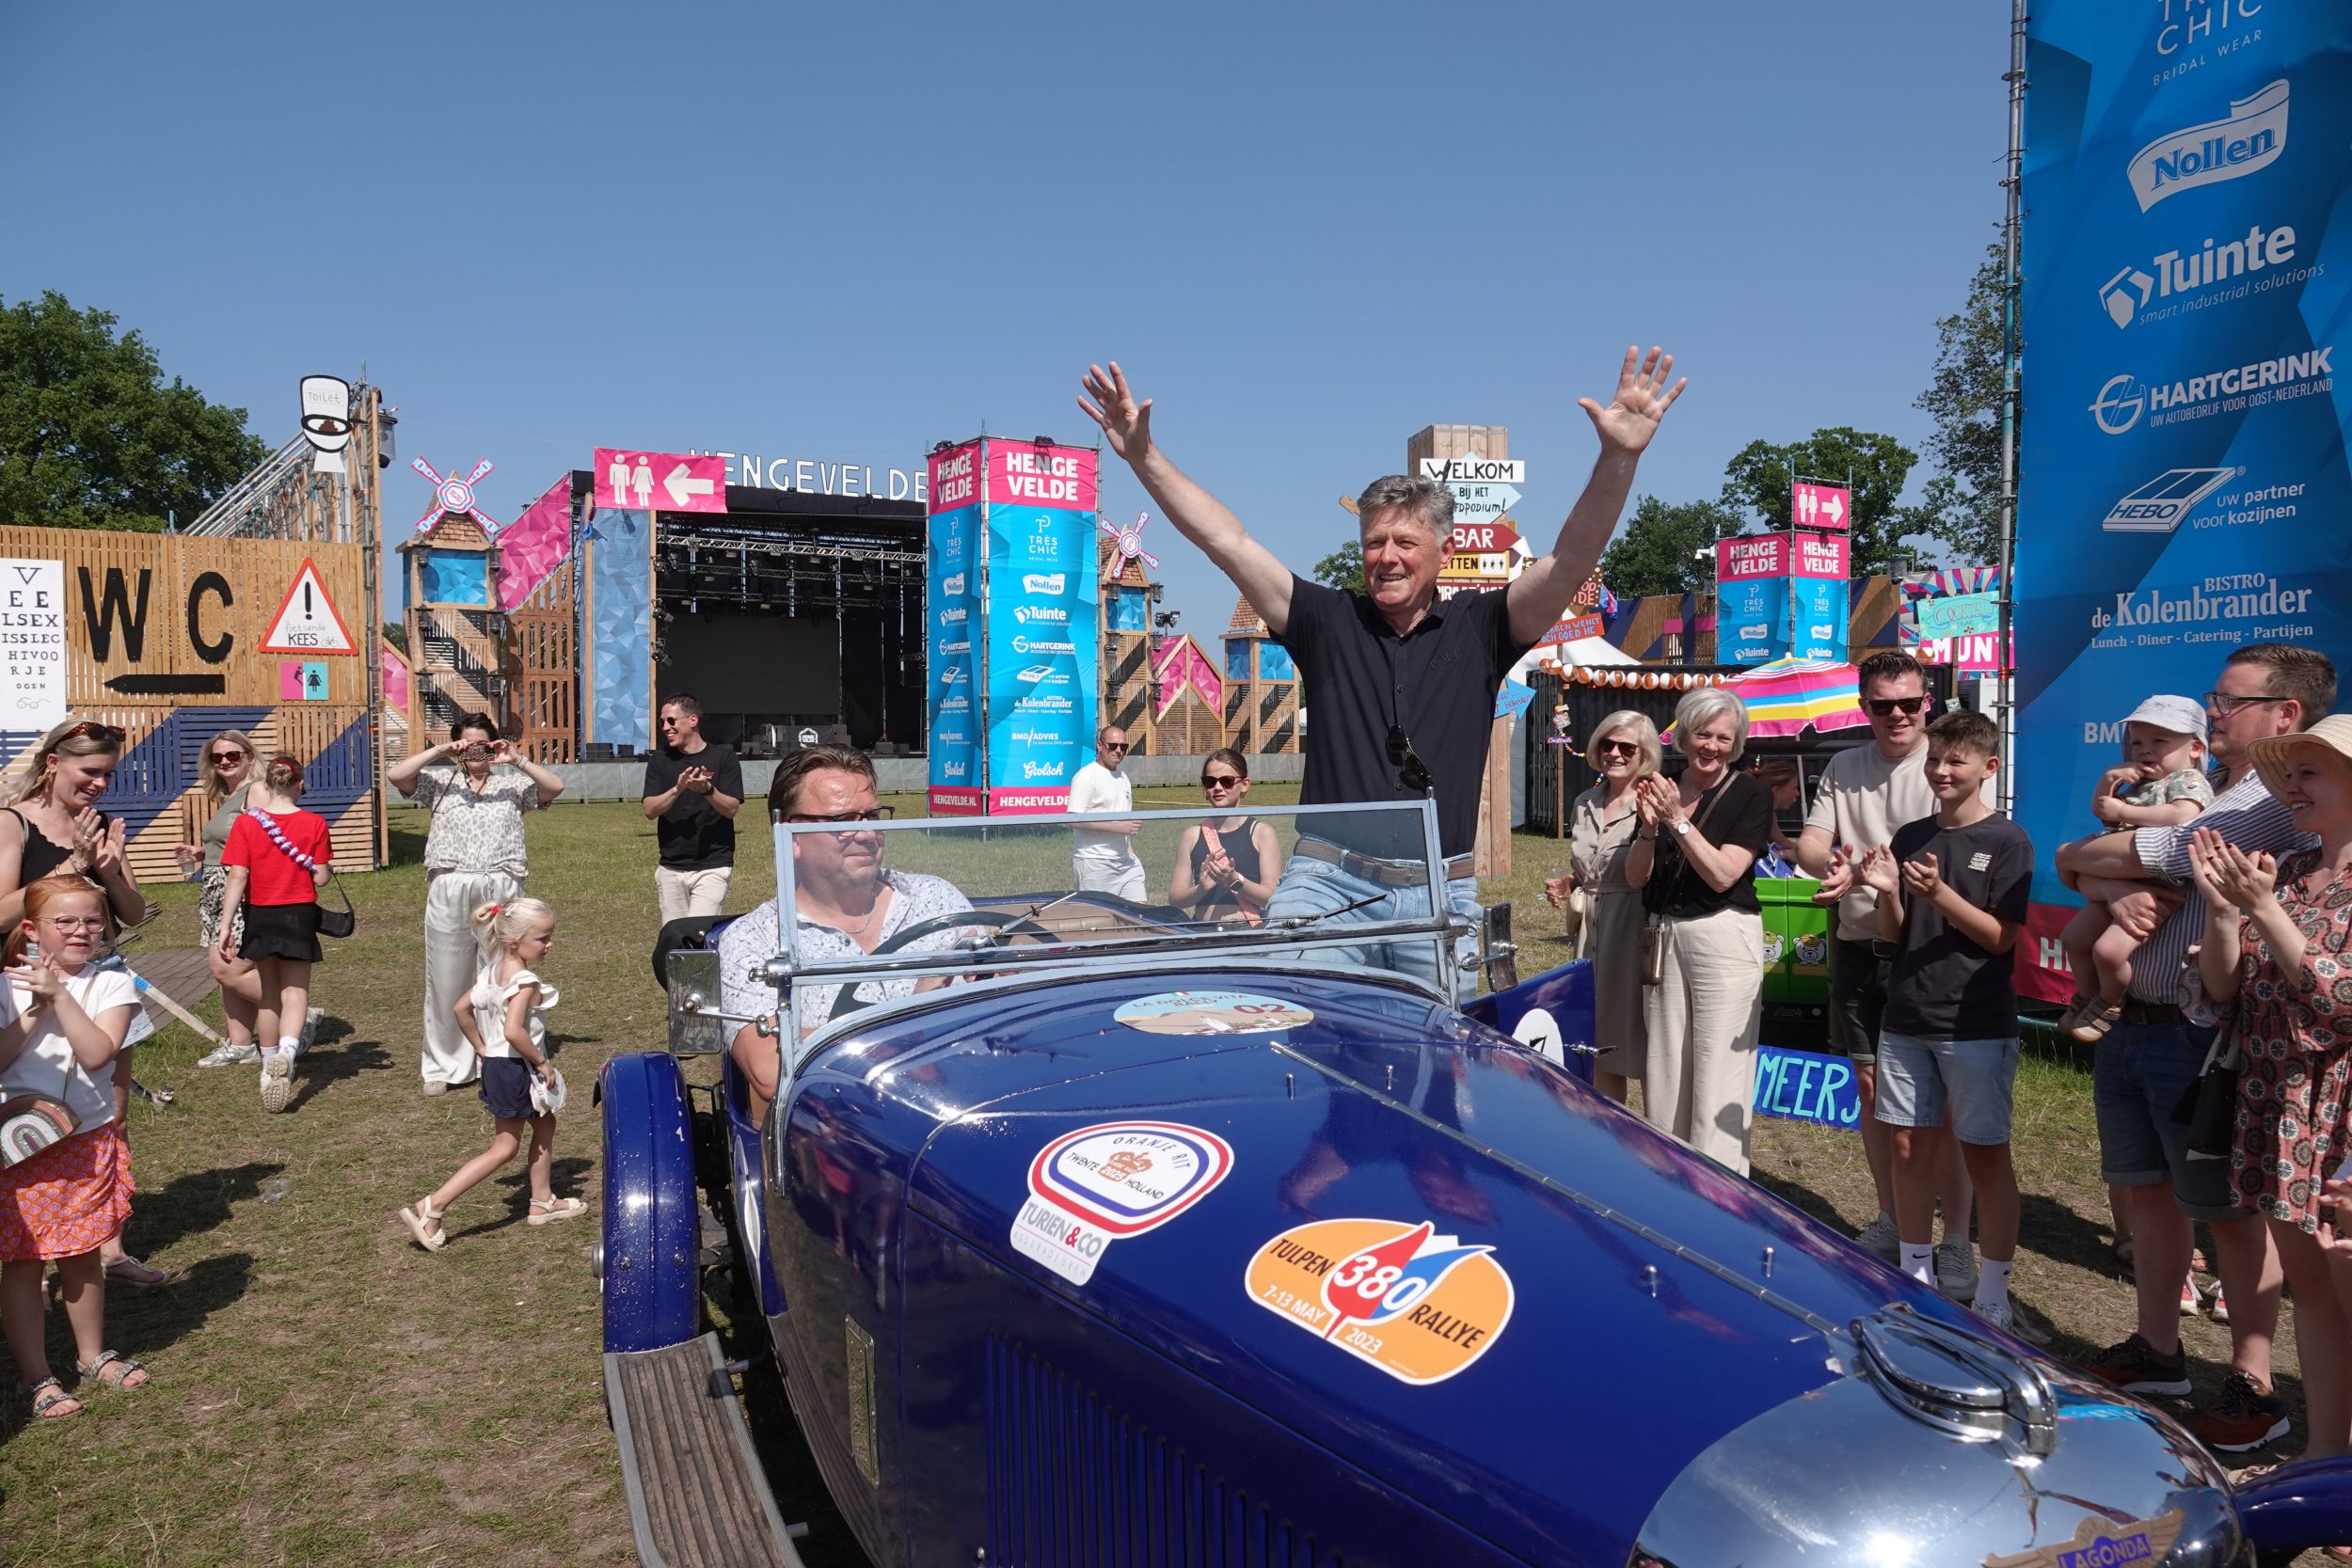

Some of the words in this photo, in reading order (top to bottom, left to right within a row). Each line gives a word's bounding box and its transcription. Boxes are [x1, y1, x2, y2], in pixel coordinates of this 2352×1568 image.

[2156, 0, 2262, 55] CHIC
[2153, 55, 2206, 86] BRIDAL
[2217, 29, 2262, 56] WEAR
[2151, 128, 2278, 187] Nollen
[2153, 225, 2296, 297] Tuinte
[2139, 304, 2178, 325] smart
[2182, 286, 2249, 313] industrial
[2253, 263, 2326, 294] solutions
[2151, 346, 2334, 411] HARTGERINK
[2151, 414, 2164, 428] UW
[2165, 402, 2221, 424] AUTOBEDRIJF
[2222, 396, 2246, 412] VOOR
[2249, 377, 2333, 406] OOST-NEDERLAND
[690, 449, 928, 503] ENGEVELDE
[937, 452, 973, 483] HENGE
[1007, 451, 1079, 478] HENGE
[1426, 459, 1514, 483] WELKOM
[937, 476, 973, 504] VELDE
[1007, 475, 1079, 501] VELDE
[1475, 486, 1489, 498] HET
[2245, 483, 2306, 506] partner
[2109, 503, 2179, 518] HEBO
[2192, 515, 2225, 530] voor
[2228, 505, 2296, 525] kozijnen
[1453, 528, 1494, 548] BAR
[1803, 541, 1839, 558] HENGE
[946, 546, 961, 557] CHIC
[1028, 545, 1057, 555] CHIC
[1730, 540, 1778, 560] HENGE
[1446, 557, 1478, 569] TTEN
[1730, 557, 1778, 576] VELDE
[1803, 557, 1839, 574] VELDE
[12, 566, 43, 585] V
[1030, 579, 1061, 591] Nollen
[2204, 572, 2265, 594] BISTRO
[946, 608, 967, 621] Tuinte
[1029, 606, 1067, 621] Tuinte
[1814, 604, 1829, 612] CHIC
[2091, 607, 2111, 628] de
[2116, 578, 2312, 626] Kolenbrander
[288, 633, 318, 646] KEES
[1558, 629, 1581, 641] GOED
[1583, 626, 1597, 636] HE
[2091, 634, 2127, 649] Lunch
[2137, 633, 2174, 646] Diner
[2184, 629, 2242, 643] Catering
[2253, 625, 2314, 640] Partijen
[1029, 641, 1075, 651] HARTGERINK
[1744, 647, 1770, 657] Tuinte
[1813, 647, 1833, 657] Tuinte
[1023, 697, 1073, 707] Kolenbrander
[2085, 721, 2127, 744] BM
[1023, 760, 1064, 780] Grolsch
[933, 794, 977, 806] HENGEVELDE.NL
[2040, 937, 2073, 973] H
[1156, 995, 1213, 1006] DOLCE
[1174, 999, 1218, 1007] RALLY
[1233, 1004, 1295, 1014] 02
[1112, 1136, 1177, 1152] ORANJE
[1170, 1153, 1191, 1169] RIT
[1067, 1152, 1101, 1171] TWENTE
[1103, 1165, 1125, 1180] 2025
[1123, 1179, 1165, 1199] HOLLAND
[1022, 1202, 1103, 1258] TURIEN&CO
[1013, 1231, 1088, 1278] ASSURADEUREN
[1269, 1238, 1335, 1277] TULPEN
[1333, 1255, 1428, 1311] 380
[1263, 1285, 1295, 1308] 7-13
[1291, 1298, 1327, 1324] MAY
[1408, 1304, 1486, 1350] RALLYE
[1344, 1327, 1383, 1354] 2023
